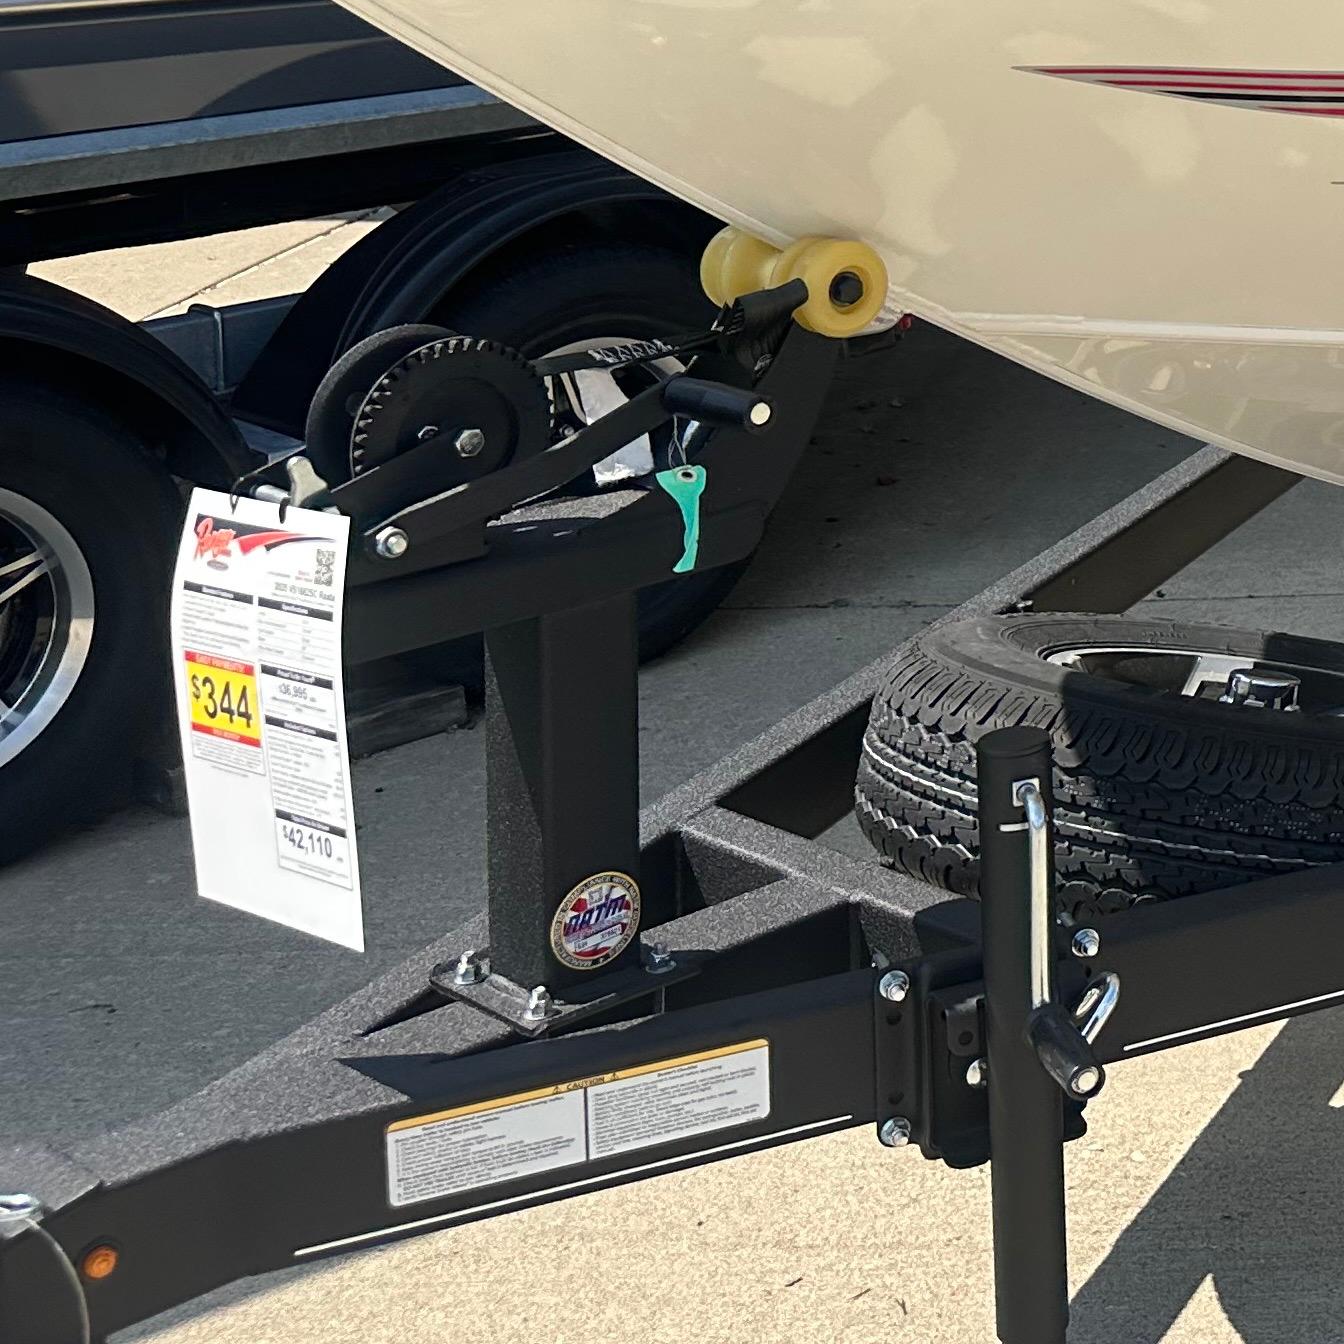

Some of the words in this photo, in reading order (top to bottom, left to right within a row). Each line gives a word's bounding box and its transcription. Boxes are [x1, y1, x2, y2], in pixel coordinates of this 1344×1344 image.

[191, 673, 253, 729] $344
[282, 824, 333, 858] $42,110
[566, 1075, 605, 1090] CAUTION
